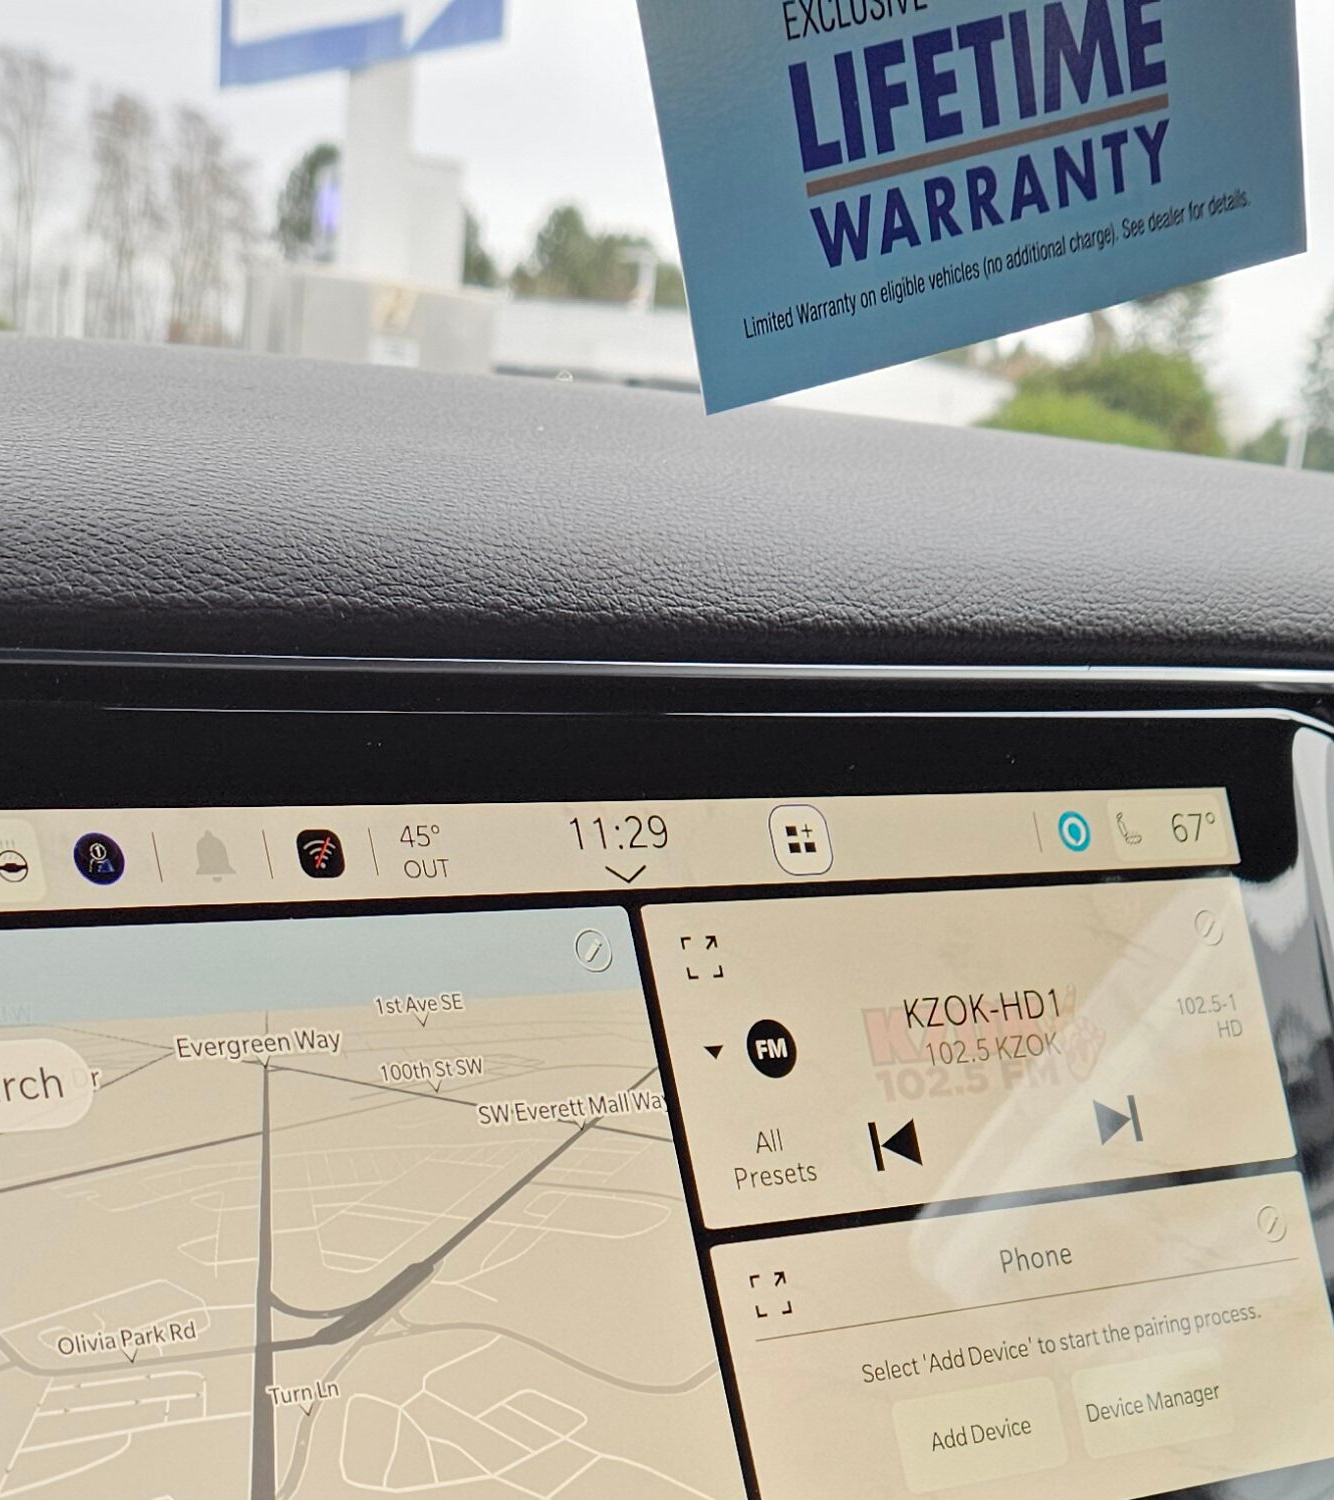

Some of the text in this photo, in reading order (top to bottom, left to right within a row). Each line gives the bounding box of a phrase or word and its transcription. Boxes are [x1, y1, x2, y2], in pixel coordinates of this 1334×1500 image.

[788, 0, 1167, 172] LIFETIME
[810, 119, 1169, 268] WARRANTY
[743, 188, 1252, 339] Limited Warranty on eligible vehicles (no additional charge). See dealer for details.
[399, 824, 440, 848] 45°
[569, 814, 668, 850] 11:29
[1171, 811, 1216, 842] 67°
[403, 858, 449, 879] OUT
[375, 993, 464, 1015] 1st Ave SE
[903, 988, 1061, 1029] KZOK-HD1
[1175, 993, 1238, 1017] 102.5-1
[1217, 1018, 1244, 1040] HD
[176, 1030, 340, 1060] Evergreen Way
[755, 1037, 788, 1060] FM
[925, 1031, 1062, 1067] 102.5 KZOK
[380, 1058, 483, 1082] 100th St SW
[478, 1091, 668, 1124] SW Everett Mall Wa
[756, 1128, 783, 1154] All
[734, 1162, 817, 1190] Presets
[999, 1246, 1072, 1274] Phone
[58, 1321, 196, 1355] Olivia Park Rd
[861, 1304, 1263, 1384] Select 'Add Device' to start the pairing process.
[268, 1381, 340, 1405] Turn Ln
[1085, 1383, 1220, 1424] Device Manager
[932, 1417, 1032, 1452] Add Device
